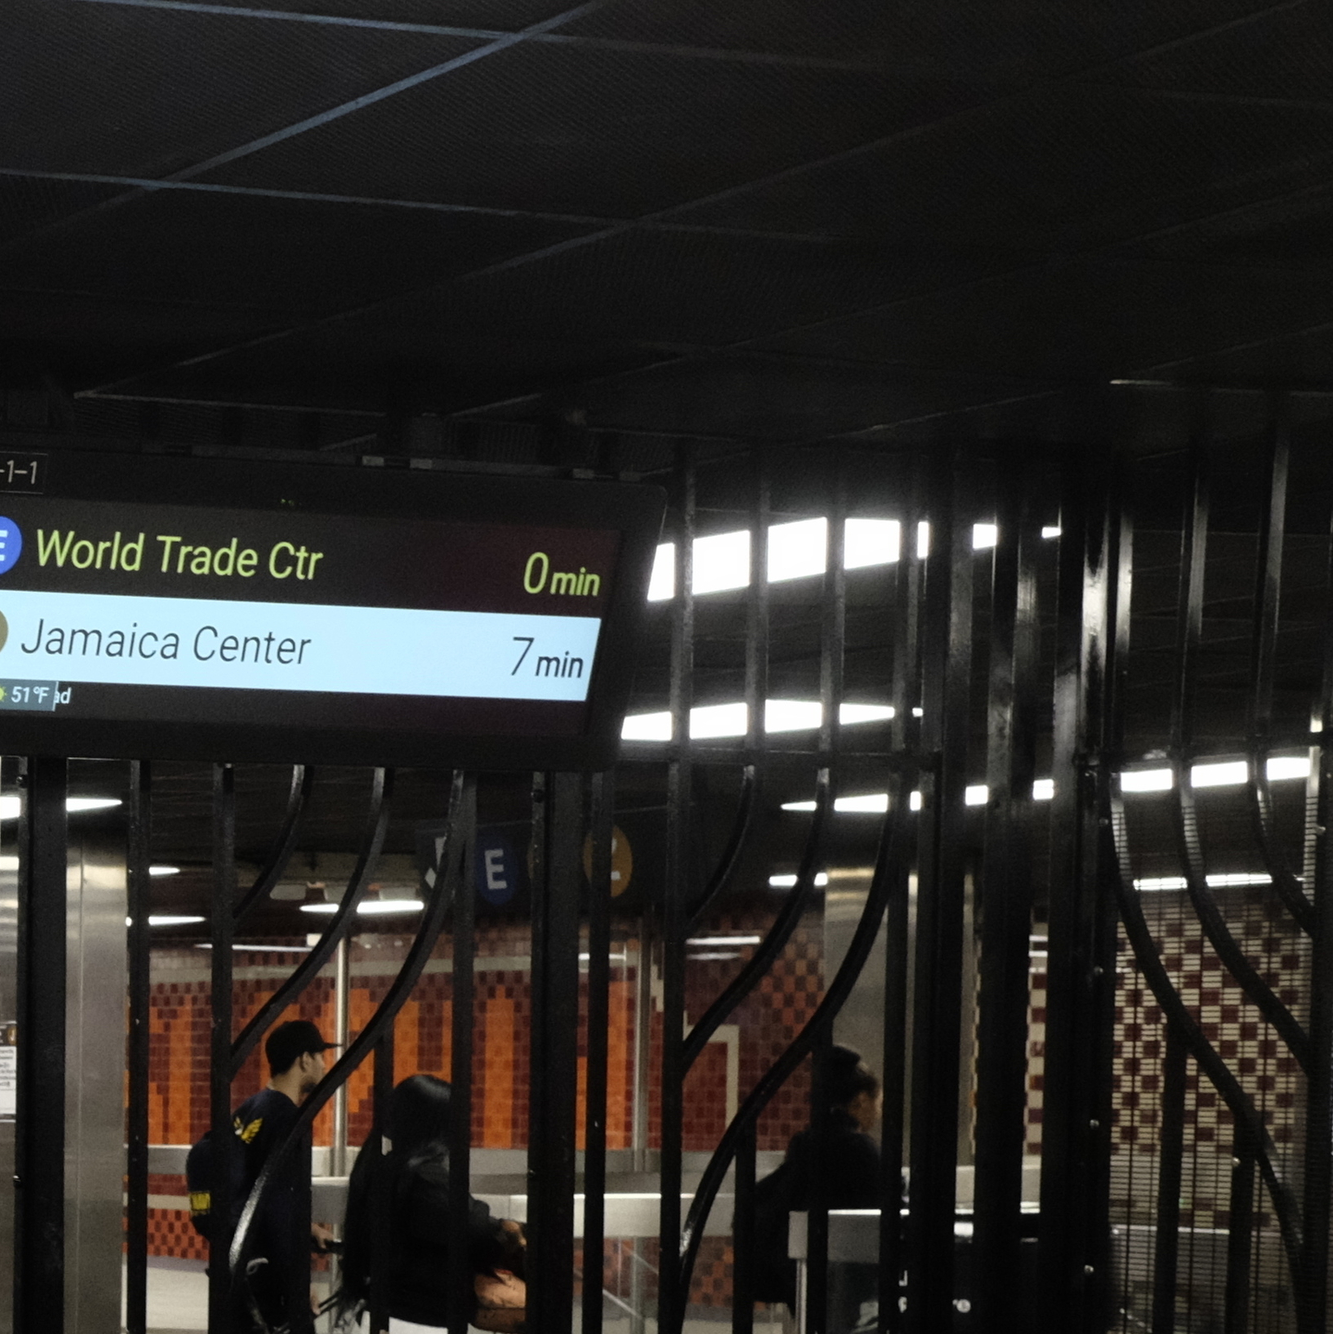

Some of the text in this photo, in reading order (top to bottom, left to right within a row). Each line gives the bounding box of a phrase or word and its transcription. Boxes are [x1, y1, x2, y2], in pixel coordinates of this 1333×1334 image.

[37, 529, 144, 571] World
[157, 535, 258, 577] Trade
[269, 541, 323, 580] Ctr
[21, 618, 180, 659] Jamaica
[194, 625, 311, 664] Center
